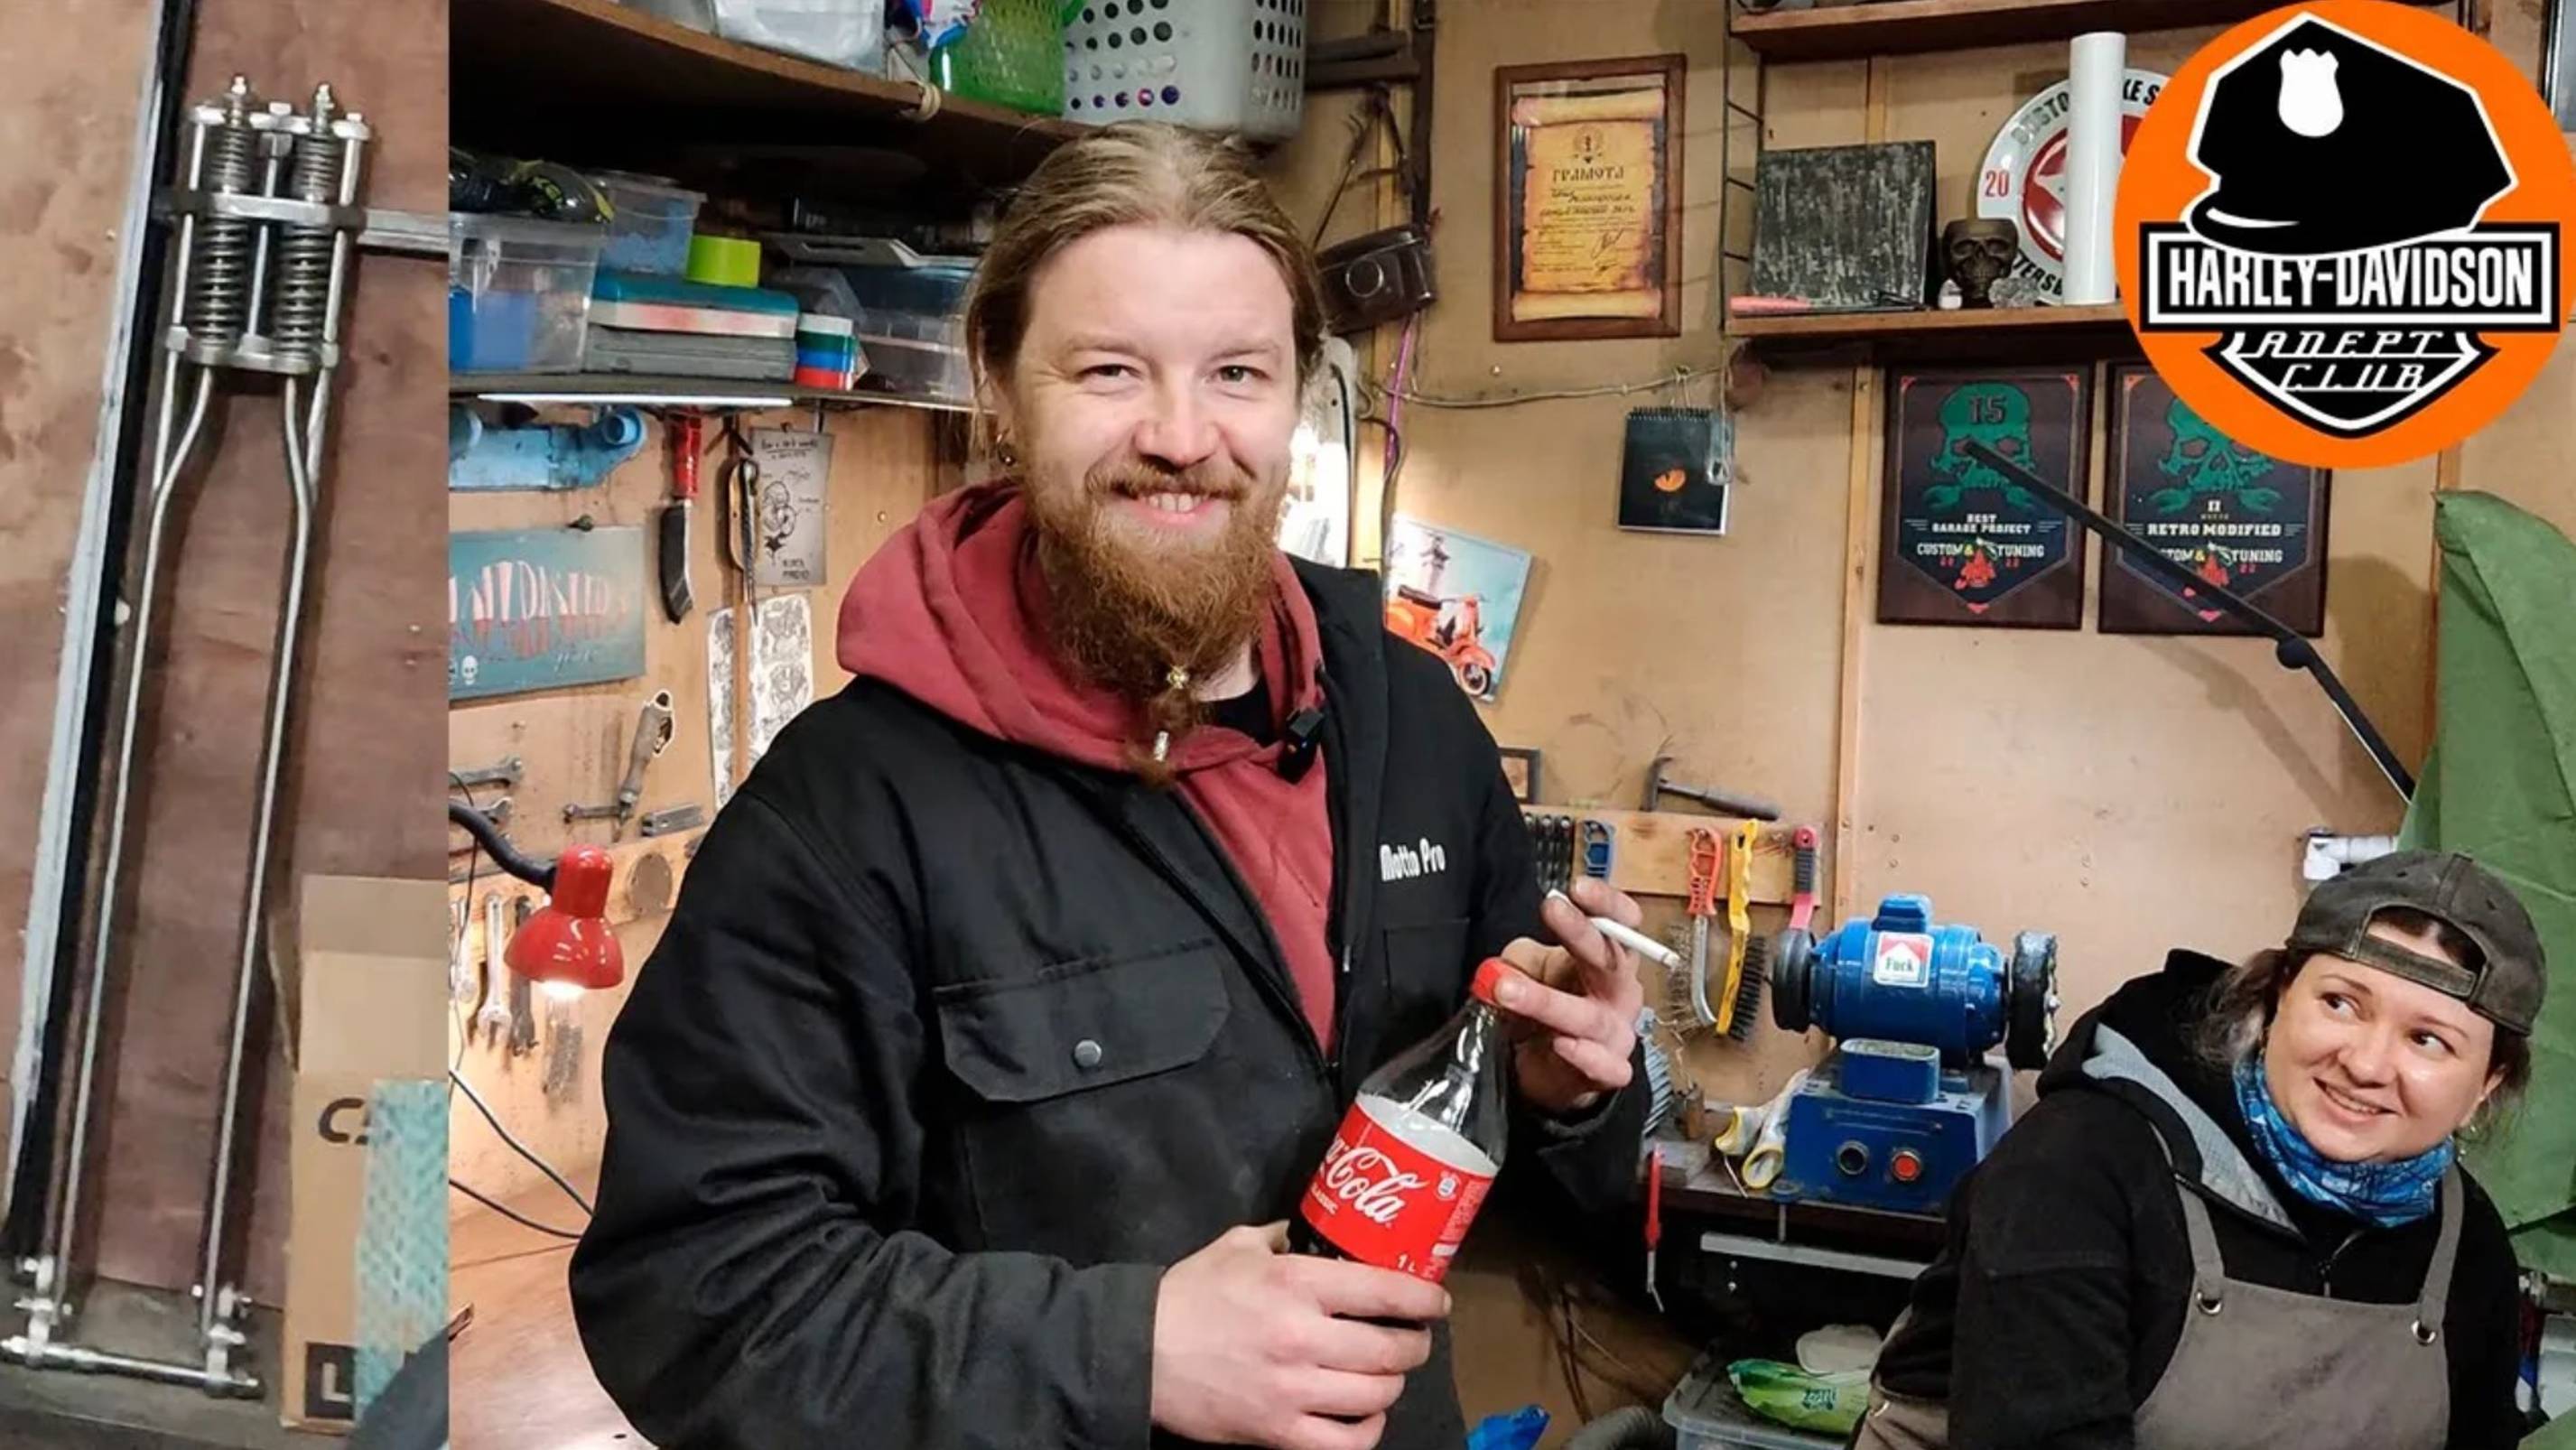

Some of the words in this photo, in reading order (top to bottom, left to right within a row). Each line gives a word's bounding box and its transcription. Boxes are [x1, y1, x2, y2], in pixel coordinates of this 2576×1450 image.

[1553, 166, 1624, 183] ГРАМОТА
[1985, 171, 2010, 198] 20
[1967, 513, 1997, 524] BEST
[1931, 523, 1977, 534] GARAGE
[1981, 524, 2032, 534] PROJECT
[2147, 523, 2200, 536] RETRO
[2202, 523, 2282, 537] MODIFIED
[1995, 544, 2045, 558] TUNING
[2230, 549, 2283, 562] TUNING
[1419, 837, 1446, 874] Pro
